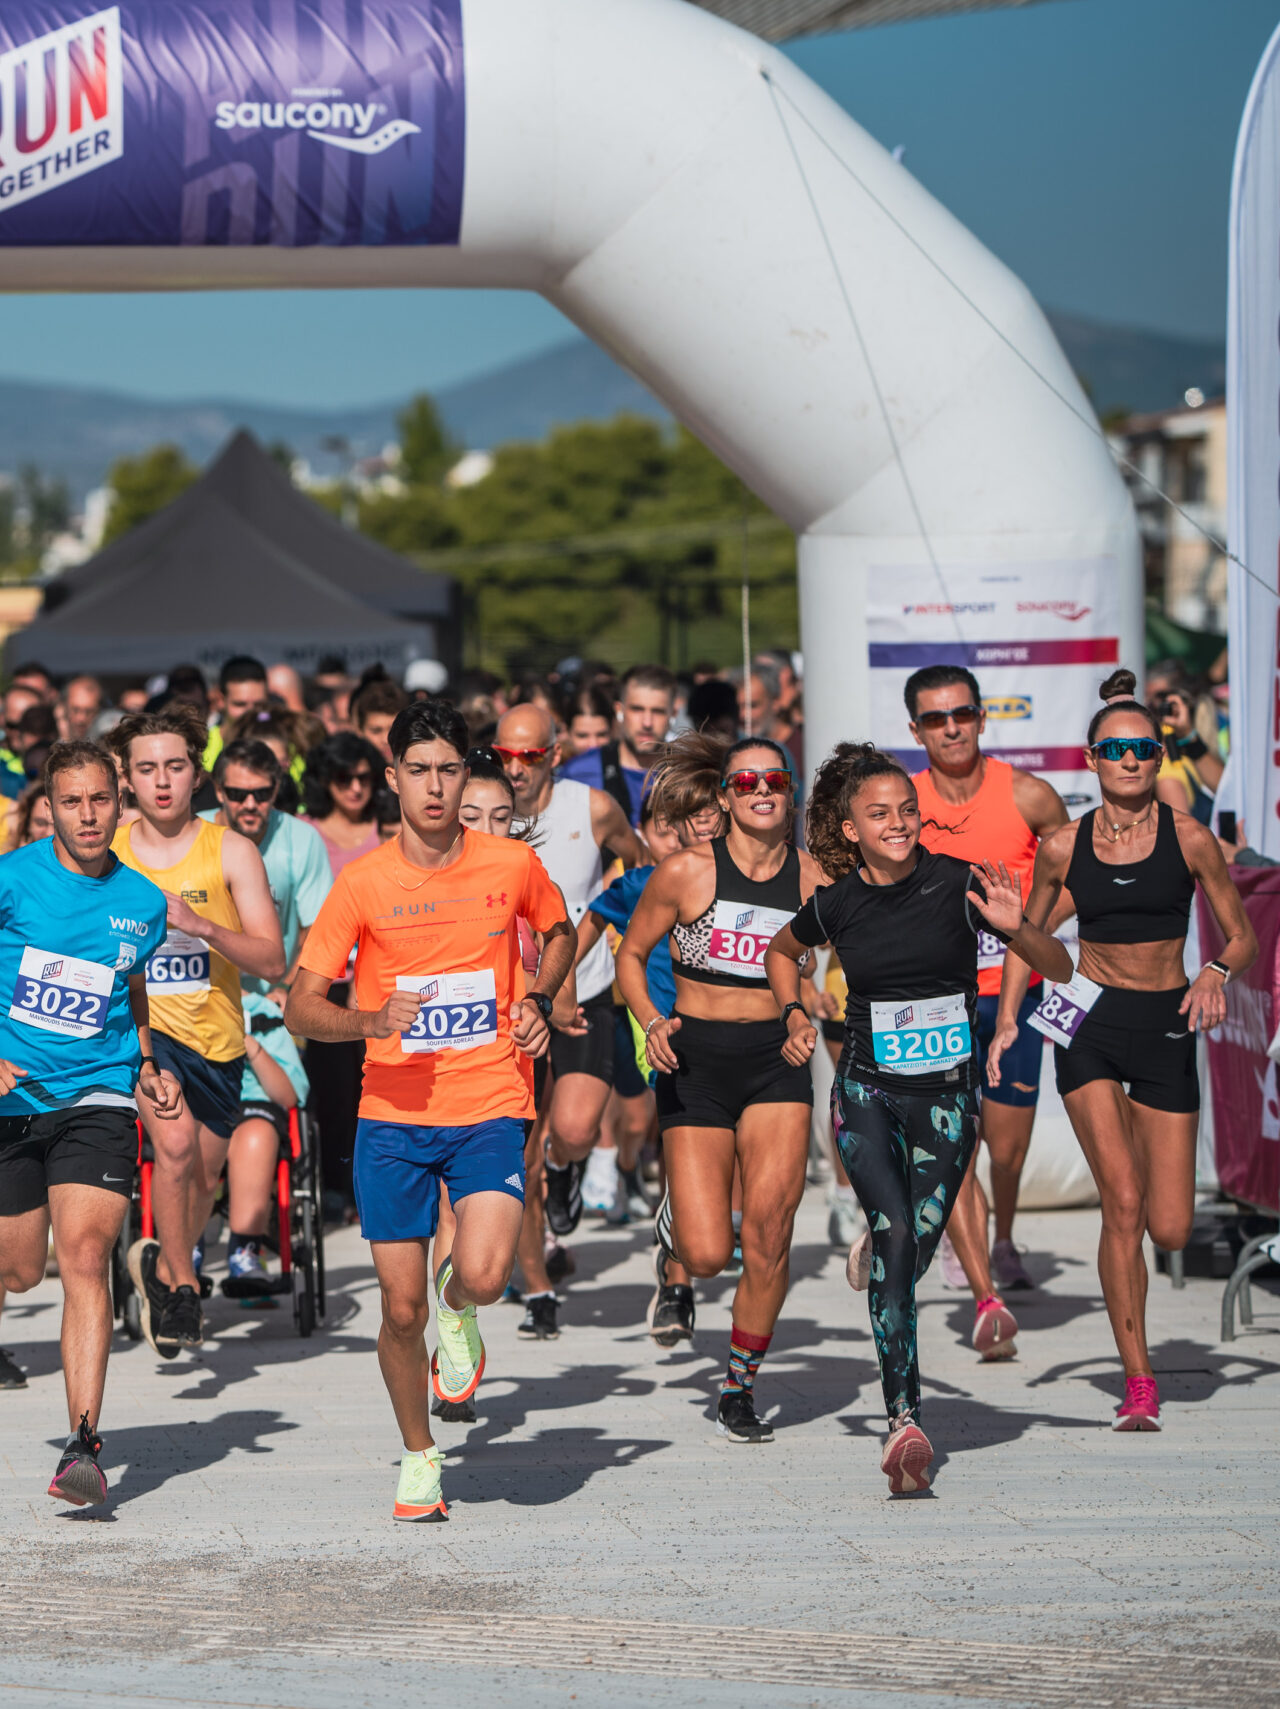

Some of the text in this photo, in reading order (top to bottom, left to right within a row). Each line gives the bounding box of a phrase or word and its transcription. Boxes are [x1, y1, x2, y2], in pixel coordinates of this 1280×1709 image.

[215, 101, 377, 135] saucony
[393, 902, 436, 917] RUN
[737, 911, 754, 928] RUN
[109, 915, 149, 937] WIND
[717, 931, 772, 964] 302
[43, 961, 63, 976] RUN
[20, 981, 101, 1024] 3022
[896, 1007, 913, 1024] RUN
[1036, 995, 1078, 1031] 84
[29, 1013, 60, 1026] MAVROUDIS
[409, 1003, 490, 1037] 3022
[883, 1026, 964, 1061] 3206
